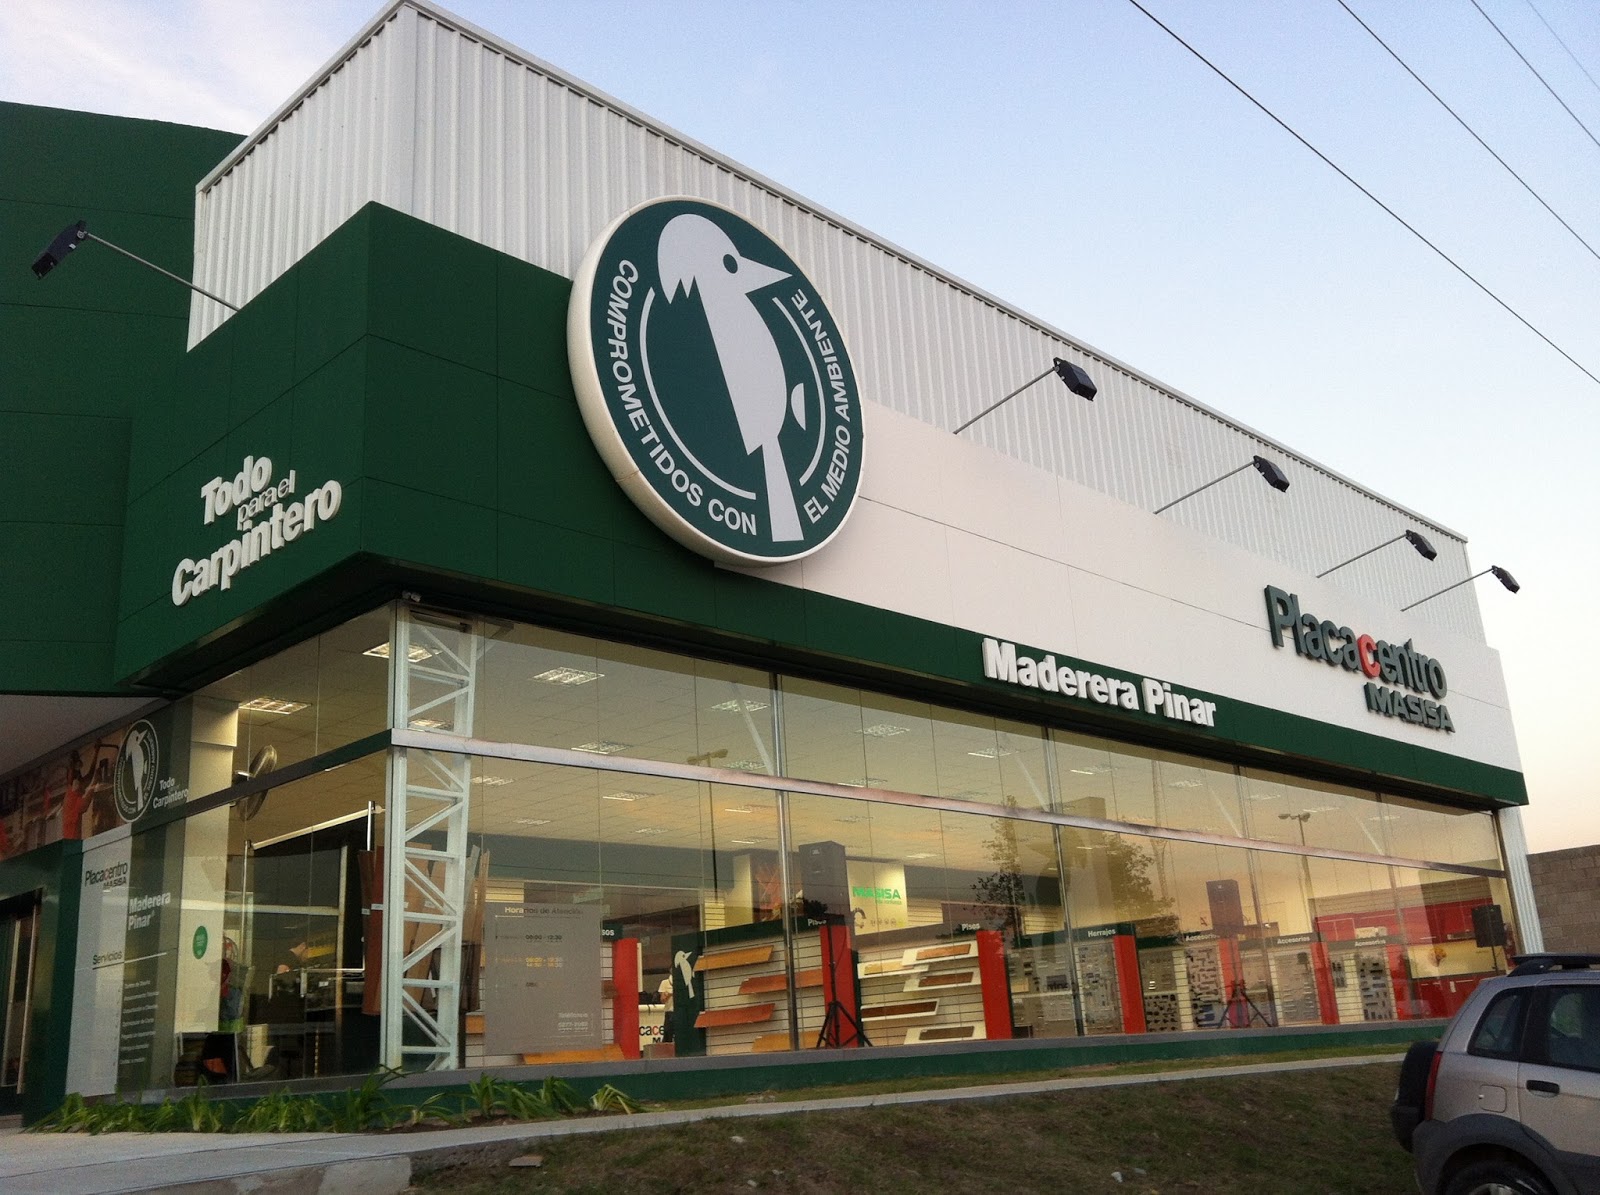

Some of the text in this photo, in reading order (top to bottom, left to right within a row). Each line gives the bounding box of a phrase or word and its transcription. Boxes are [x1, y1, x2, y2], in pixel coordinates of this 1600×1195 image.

[607, 259, 757, 536] COMPROMETIDOS CON
[790, 288, 851, 524] EL MEDIO AMBIENTE
[201, 455, 273, 525] Todo
[237, 470, 296, 531] para el
[172, 480, 342, 606] Carpintero
[1264, 585, 1448, 699] Placacentro
[981, 637, 1218, 728] Maderera Pinar
[1363, 682, 1456, 733] MASISA
[152, 788, 189, 809] Carpintero
[159, 777, 176, 791] Todo
[84, 861, 128, 888] Placacentro
[103, 876, 128, 888] MASISA
[852, 886, 902, 900] MASISA
[128, 913, 152, 931] Pinar
[129, 892, 172, 914] Maderera
[1087, 928, 1117, 938] Herrajes
